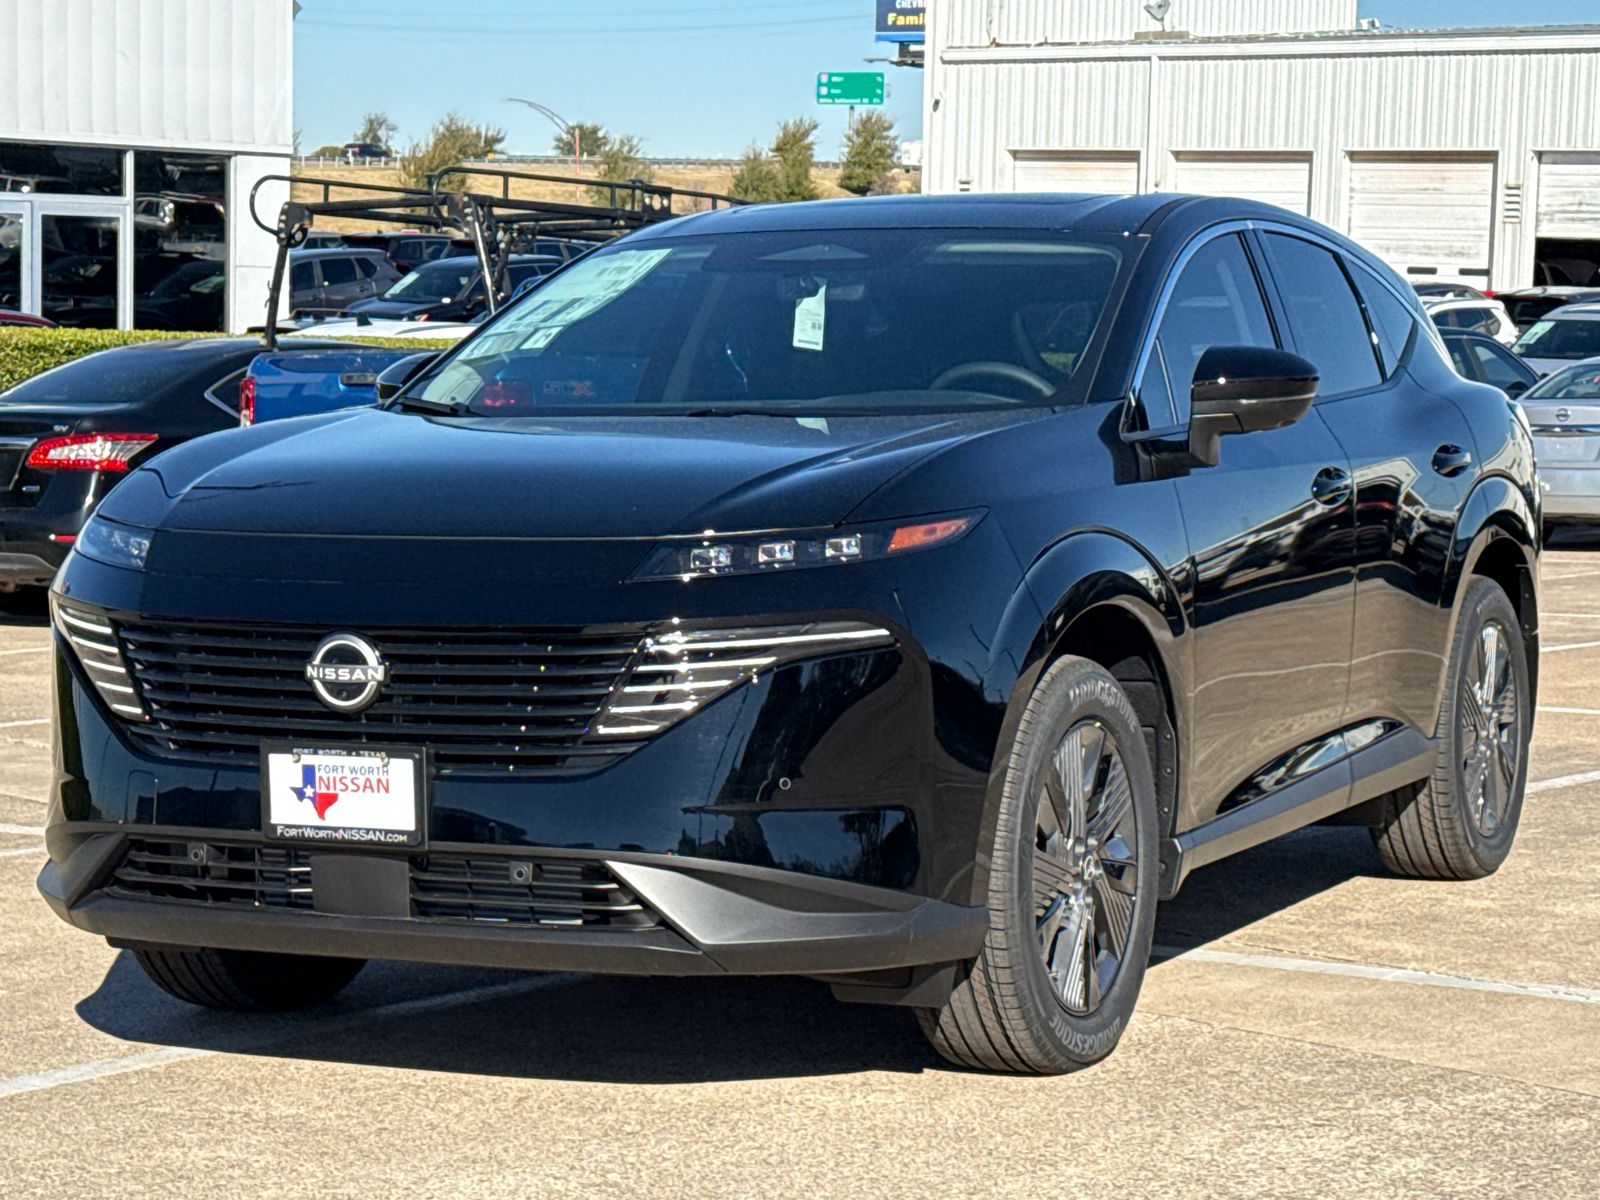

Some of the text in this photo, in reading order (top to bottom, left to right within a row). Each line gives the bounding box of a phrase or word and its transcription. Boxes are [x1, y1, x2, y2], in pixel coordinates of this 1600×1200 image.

[306, 665, 382, 680] NISSAN
[292, 747, 386, 758] FORT WORTH TEXAS
[317, 764, 389, 776] FORT WORTH
[318, 775, 390, 794] NISSAN
